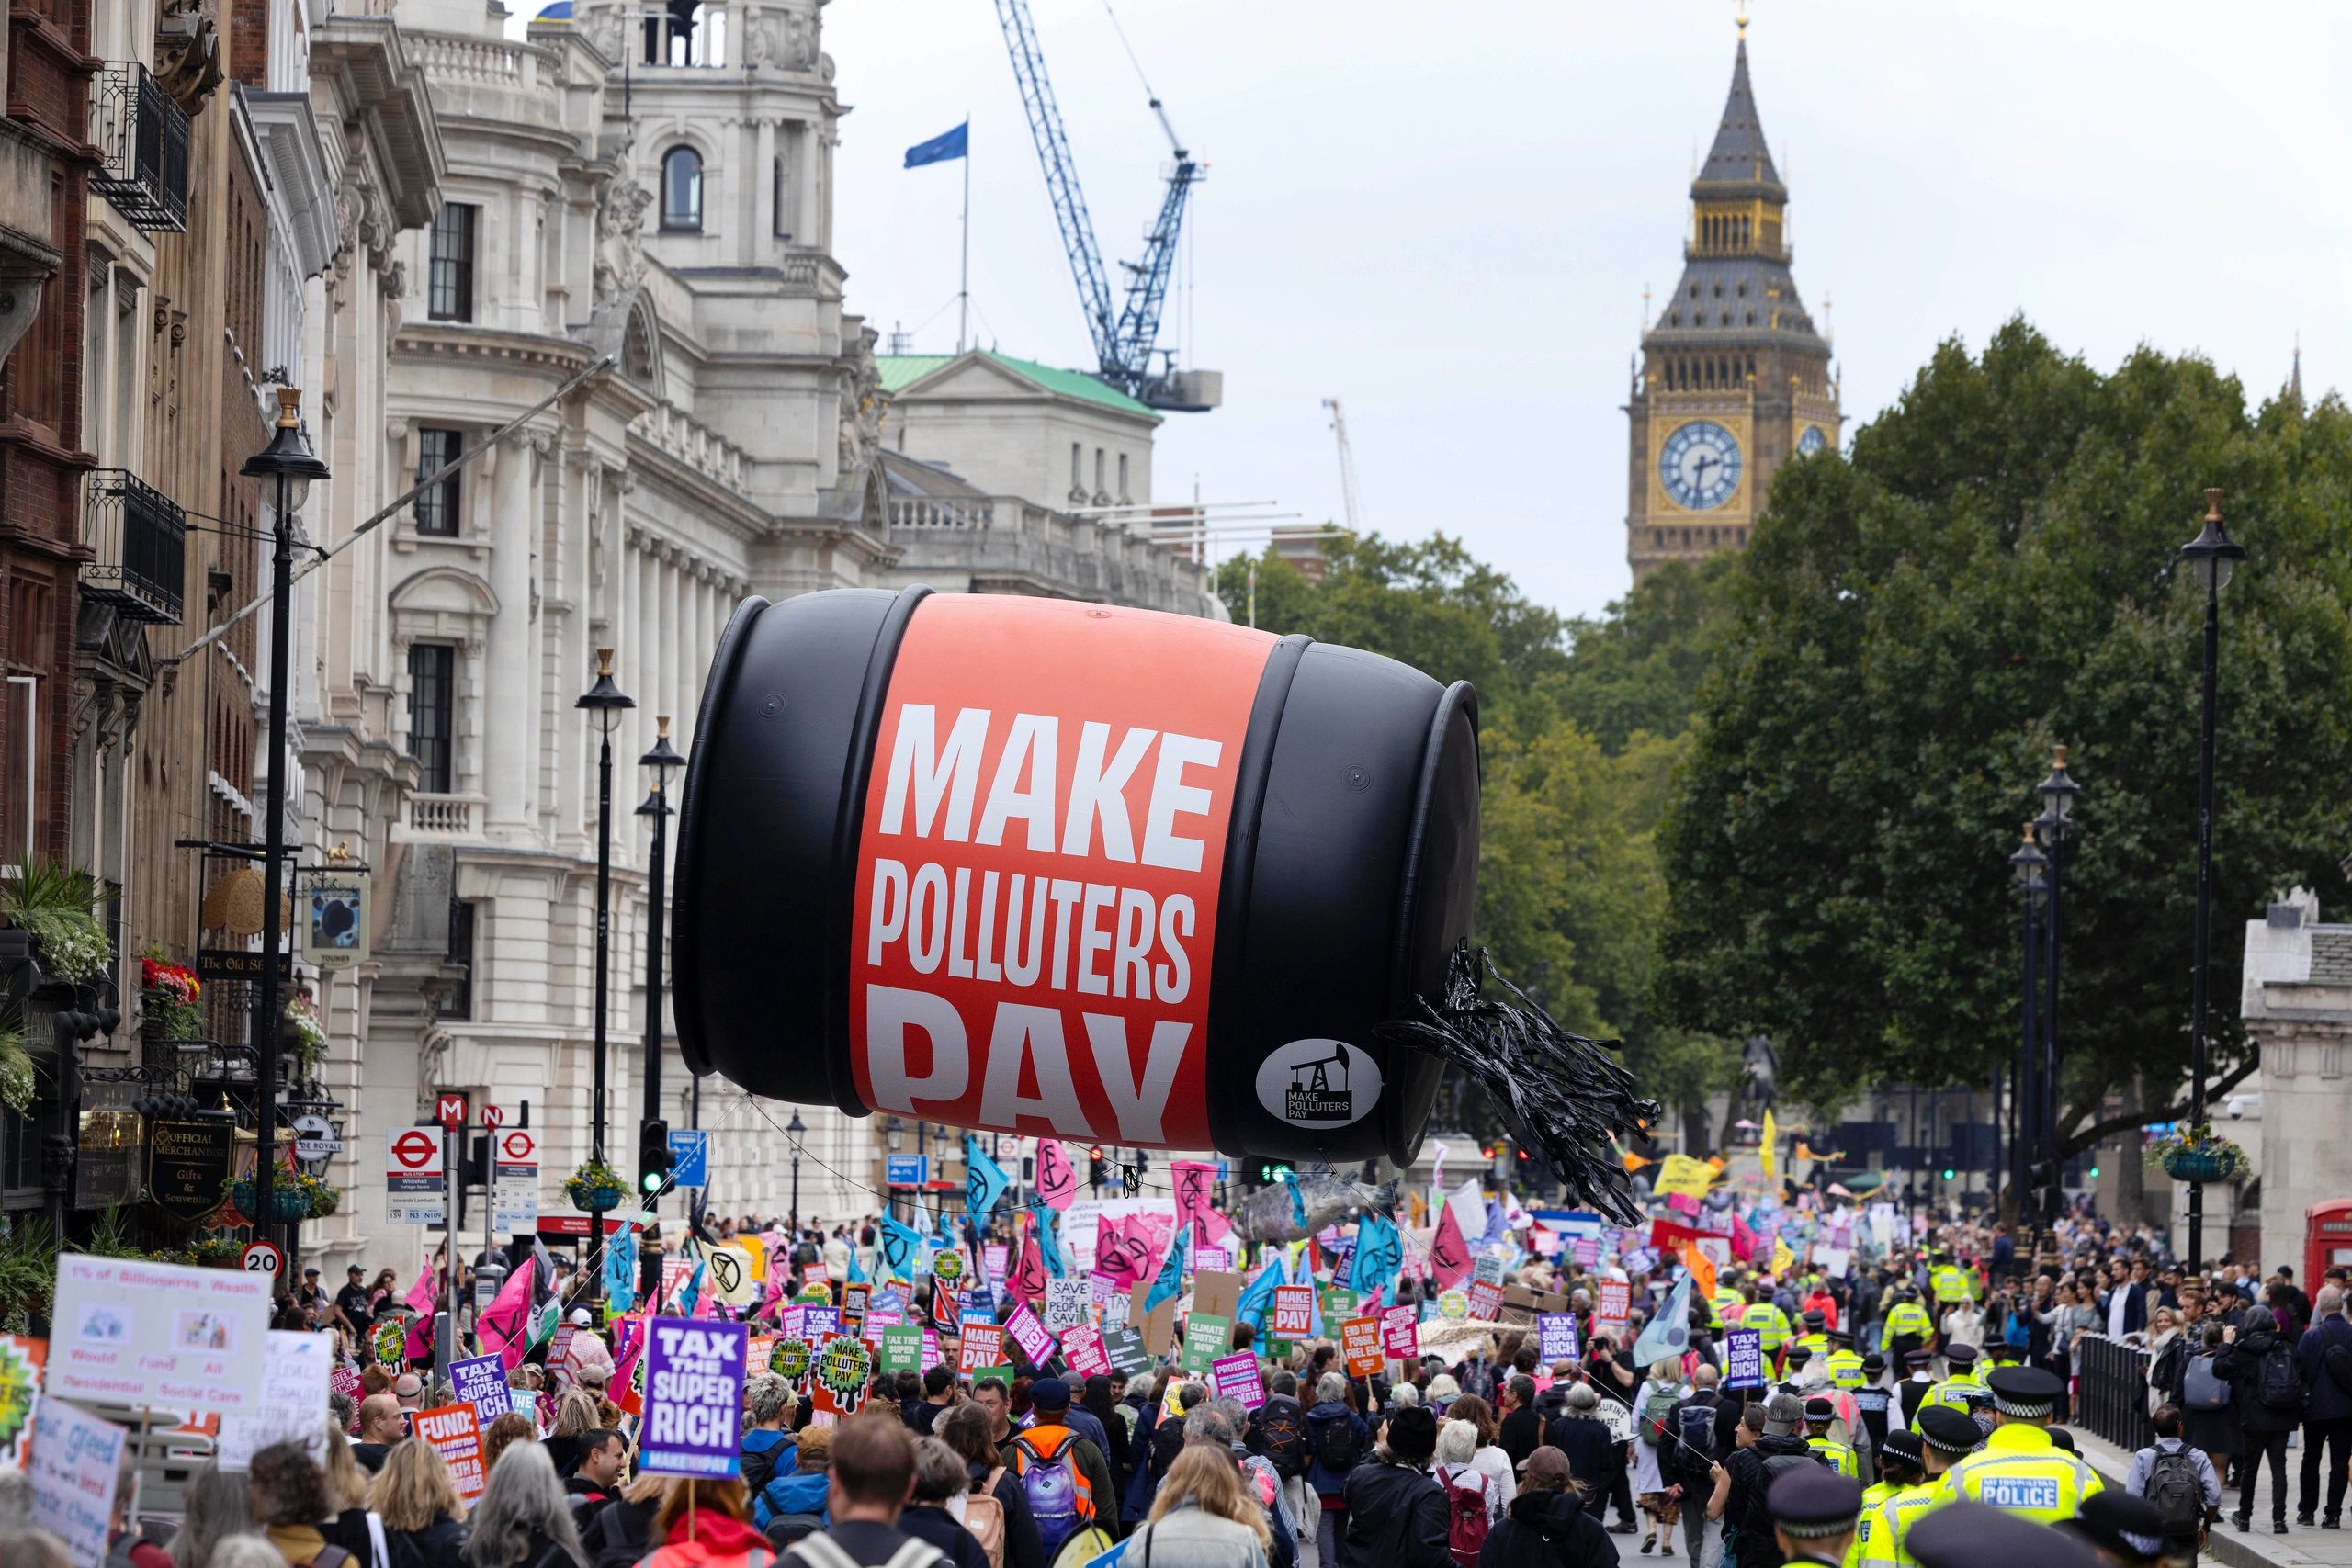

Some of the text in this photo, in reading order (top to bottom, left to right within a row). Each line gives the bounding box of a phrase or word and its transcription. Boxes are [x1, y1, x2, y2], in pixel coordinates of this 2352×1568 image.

[880, 704, 1223, 872] MAKE
[867, 858, 1195, 1005] POLLUTERS
[226, 957, 244, 971] Old
[865, 984, 1193, 1145] PAY
[1288, 1091, 1318, 1102] MAKE
[441, 1100, 462, 1121] M
[1288, 1101, 1349, 1111] POLLUTERS
[484, 1108, 502, 1125] N
[1288, 1110, 1307, 1119] PAY
[169, 1133, 212, 1145] OFFICIAL
[313, 1142, 343, 1150] ROYALE
[155, 1145, 227, 1157] MERCHANDISE
[176, 1169, 202, 1181] Gifts
[184, 1183, 194, 1193] &
[164, 1193, 211, 1205] Souvenirs
[248, 1254, 277, 1272] 20
[119, 1270, 200, 1291] Billionaires
[210, 1279, 260, 1295] Wealth
[1053, 1282, 1088, 1294] SAVE
[1277, 1290, 1310, 1303] MAKE
[1600, 1285, 1628, 1296] MAKE
[1049, 1302, 1088, 1313] PEOPLE
[1108, 1293, 1132, 1310] TAX
[784, 1310, 805, 1321] PROTE
[807, 1310, 837, 1321] TAX
[1470, 1301, 1496, 1322] PAY
[1600, 1302, 1628, 1317] PAY
[962, 1314, 992, 1325] MAKE
[1009, 1307, 1031, 1333] PROTECT
[1275, 1310, 1310, 1330] PAY
[1542, 1316, 1573, 1326] TAX
[381, 1325, 397, 1338] MAKE
[805, 1325, 835, 1335] SUPER
[964, 1327, 1001, 1345] MAKE
[1190, 1322, 1226, 1336] CLIMATE
[1343, 1323, 1375, 1337] END THE
[1543, 1331, 1575, 1341] SUPER
[375, 1333, 404, 1352] POLLUTERS
[657, 1327, 739, 1361] TAX
[884, 1336, 920, 1346] TAX THE
[1022, 1324, 1046, 1355] NOT
[1188, 1331, 1224, 1345] JUSTICE
[1348, 1334, 1376, 1348] FOSSIL
[1729, 1333, 1758, 1346] TAX
[387, 1347, 397, 1358] PAY
[781, 1345, 803, 1355] MAKE
[834, 1344, 861, 1359] MAKE
[888, 1345, 916, 1355] SUPER
[964, 1341, 1000, 1353] POLLUTERS
[1194, 1342, 1215, 1353] NOW
[1346, 1347, 1366, 1359] FUEL
[1544, 1341, 1576, 1355] RICH
[71, 1348, 224, 1374] Would Fund All
[770, 1353, 811, 1364] POLLUTERS
[891, 1354, 911, 1364] RICH
[961, 1349, 999, 1370] PAY
[1072, 1347, 1101, 1364] CLIMATE
[1730, 1349, 1758, 1363] SUPER
[456, 1359, 501, 1380] TAX
[668, 1356, 723, 1376] THE
[782, 1363, 800, 1372] PAY
[820, 1354, 871, 1375] POLLUTERS
[1075, 1355, 1102, 1372] CHANGE
[1216, 1359, 1256, 1376] PROTECT:
[1731, 1360, 1759, 1378] RICH
[465, 1374, 494, 1386] THE
[834, 1370, 852, 1383] PAY
[62, 1374, 242, 1403] Residential Social Care
[459, 1380, 505, 1403] SUPER
[652, 1370, 736, 1407] SUPER
[1221, 1382, 1253, 1397] NATURE
[511, 1393, 536, 1410] THE
[1235, 1390, 1263, 1404] MATE
[475, 1394, 509, 1420] ICH
[418, 1411, 476, 1444] FUND:
[650, 1402, 735, 1449] RICH
[1982, 1478, 2057, 1488] METROPOLITAN
[1983, 1485, 2056, 1506] POLICE
